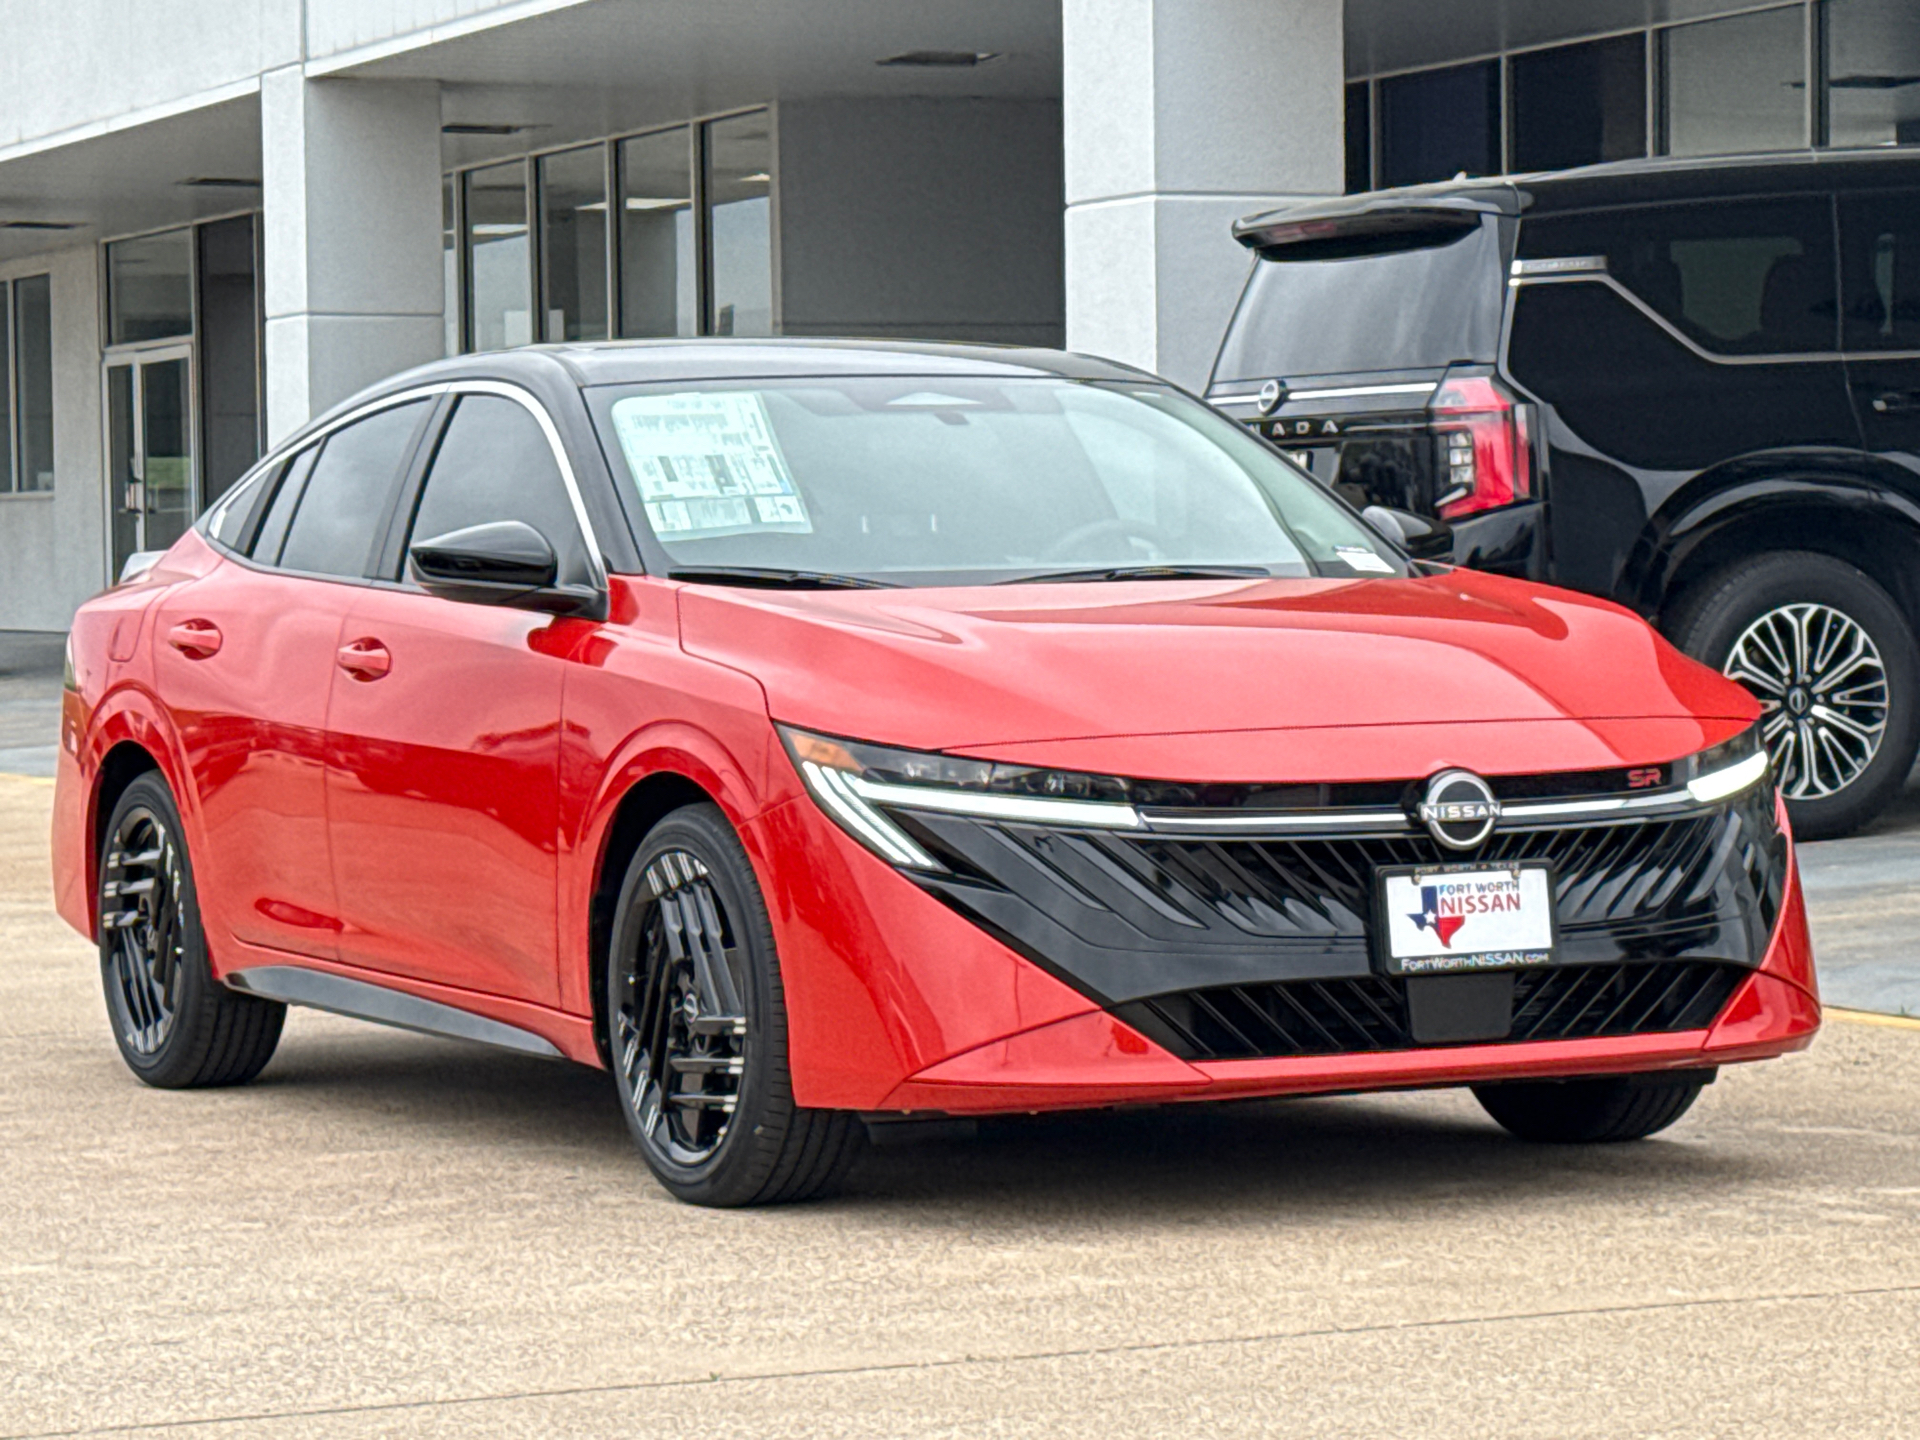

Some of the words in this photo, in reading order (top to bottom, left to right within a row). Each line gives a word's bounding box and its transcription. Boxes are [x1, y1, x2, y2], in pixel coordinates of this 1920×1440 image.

[1627, 768, 1662, 788] SR
[1423, 804, 1500, 819] NISSAN
[1439, 883, 1472, 895] FORT
[1475, 881, 1520, 893] WORTH
[1440, 893, 1521, 915] NISSAN
